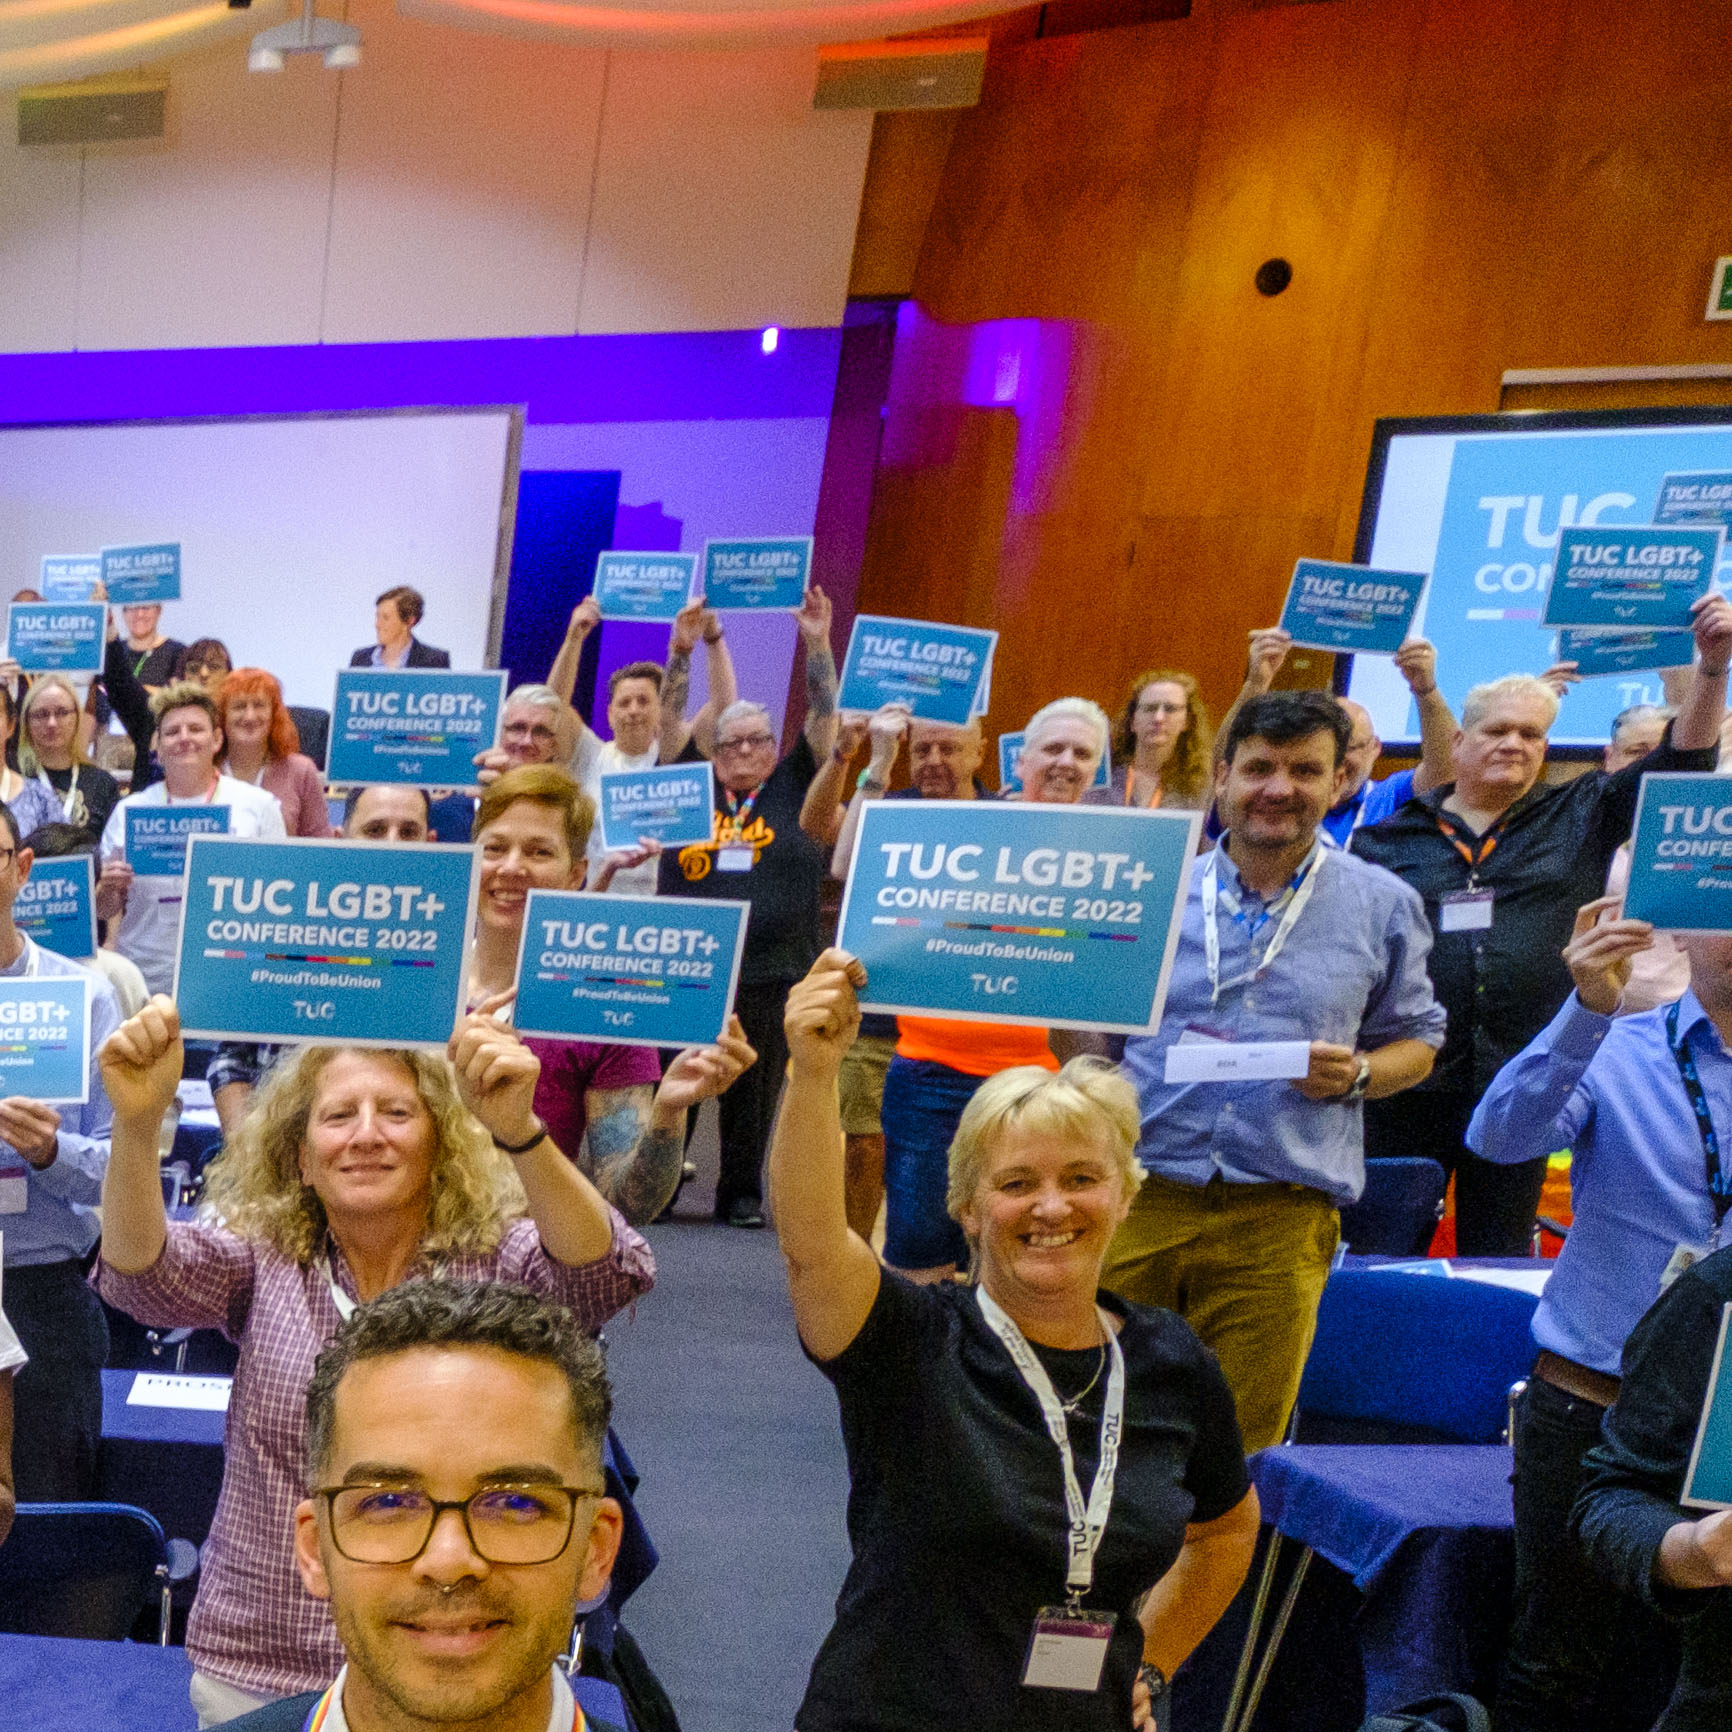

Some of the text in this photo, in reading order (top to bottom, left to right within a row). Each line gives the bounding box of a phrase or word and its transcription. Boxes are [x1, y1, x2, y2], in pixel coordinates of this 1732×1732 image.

[1477, 492, 1637, 549] TUC
[1569, 544, 1704, 565] TUC LGBT+
[1301, 576, 1409, 602] TUC LGBT+
[346, 691, 486, 715] TUC LGBT+
[879, 840, 1154, 890] TUC LGBT+
[205, 877, 444, 921] TUC LGBT+
[876, 886, 1142, 923] CONFERENCE 2022
[205, 920, 436, 952] CONFERENCE 2022
[540, 920, 719, 956] TUC LGBT+
[539, 951, 712, 978] CONFERENCE 2022
[28, 1027, 68, 1041] 2022
